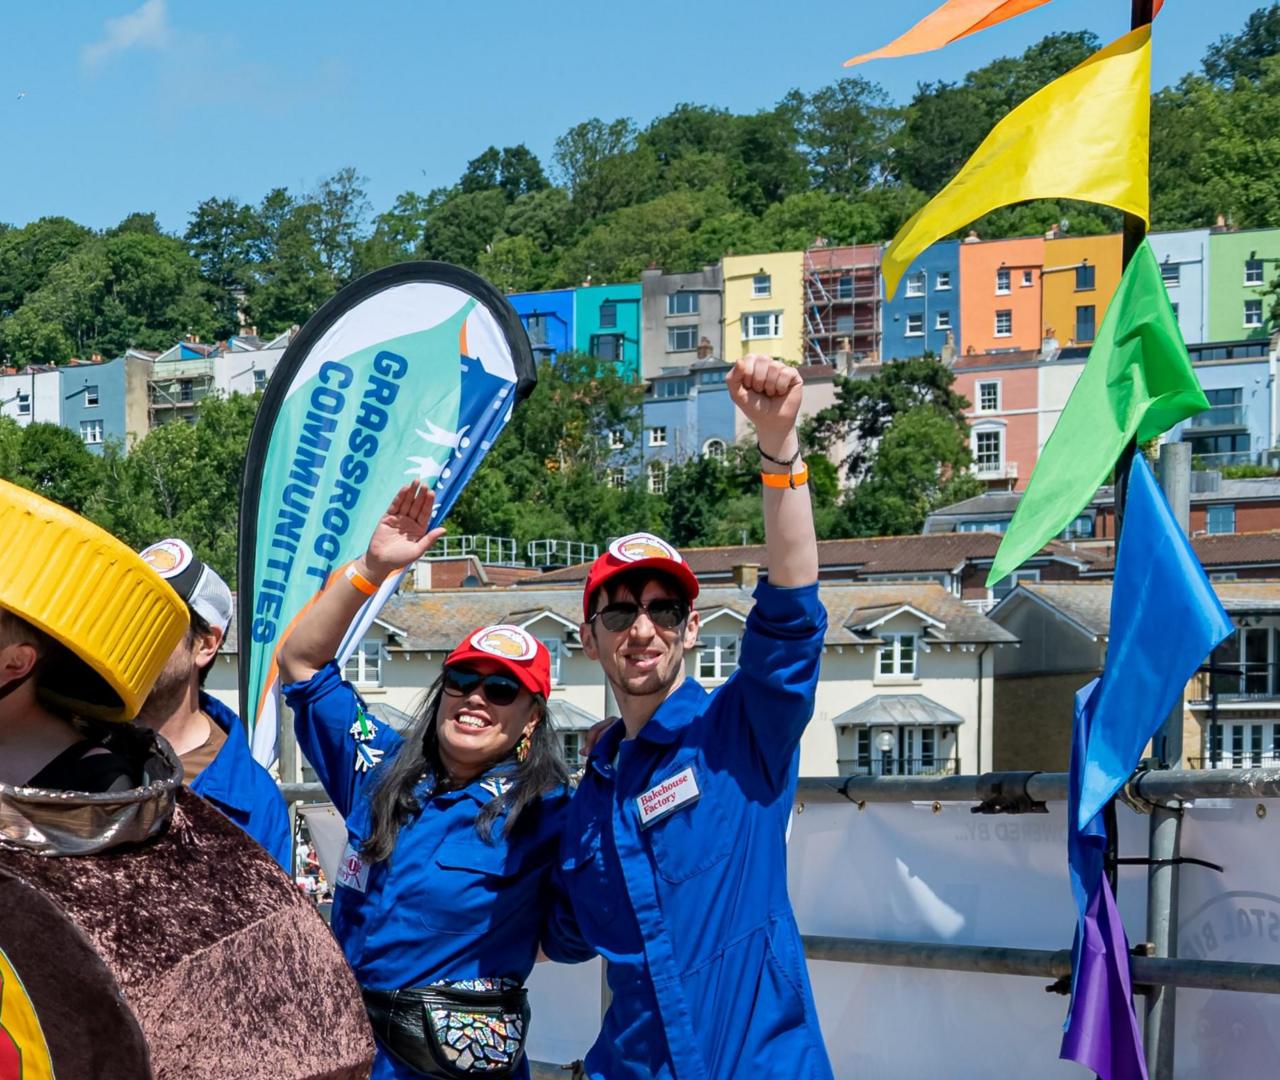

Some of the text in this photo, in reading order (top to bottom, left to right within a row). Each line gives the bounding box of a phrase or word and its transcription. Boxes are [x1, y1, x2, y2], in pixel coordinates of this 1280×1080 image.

[250, 360, 354, 645] COMMUNITIES
[305, 350, 409, 592] GRASSROOT
[640, 774, 688, 806] Bakehouse
[643, 793, 676, 815] Factory
